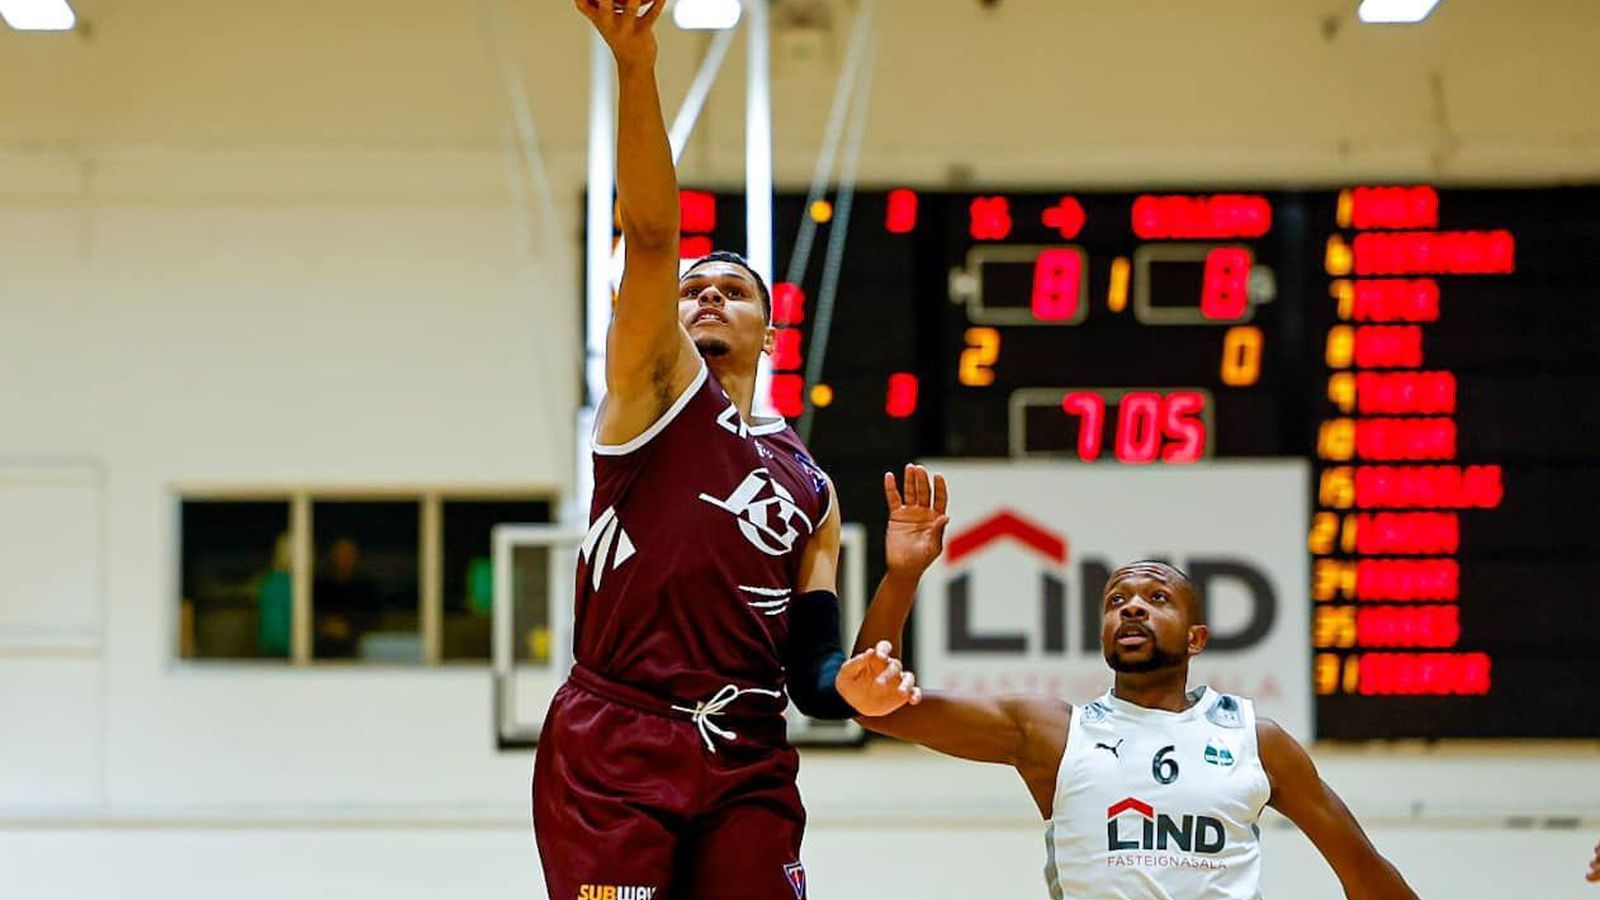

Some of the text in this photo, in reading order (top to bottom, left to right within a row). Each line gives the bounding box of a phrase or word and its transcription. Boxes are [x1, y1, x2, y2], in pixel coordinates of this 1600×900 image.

[1031, 246, 1082, 321] 8
[1108, 256, 1130, 312] 1
[1201, 246, 1252, 320] 8
[959, 327, 1000, 386] 2
[1221, 326, 1264, 386] 0
[946, 557, 1278, 655] LID
[1152, 745, 1179, 785] 6
[1107, 813, 1226, 854] LIND
[1107, 854, 1228, 870] FASTEIGNASALA
[577, 884, 657, 900] SUBWAY
